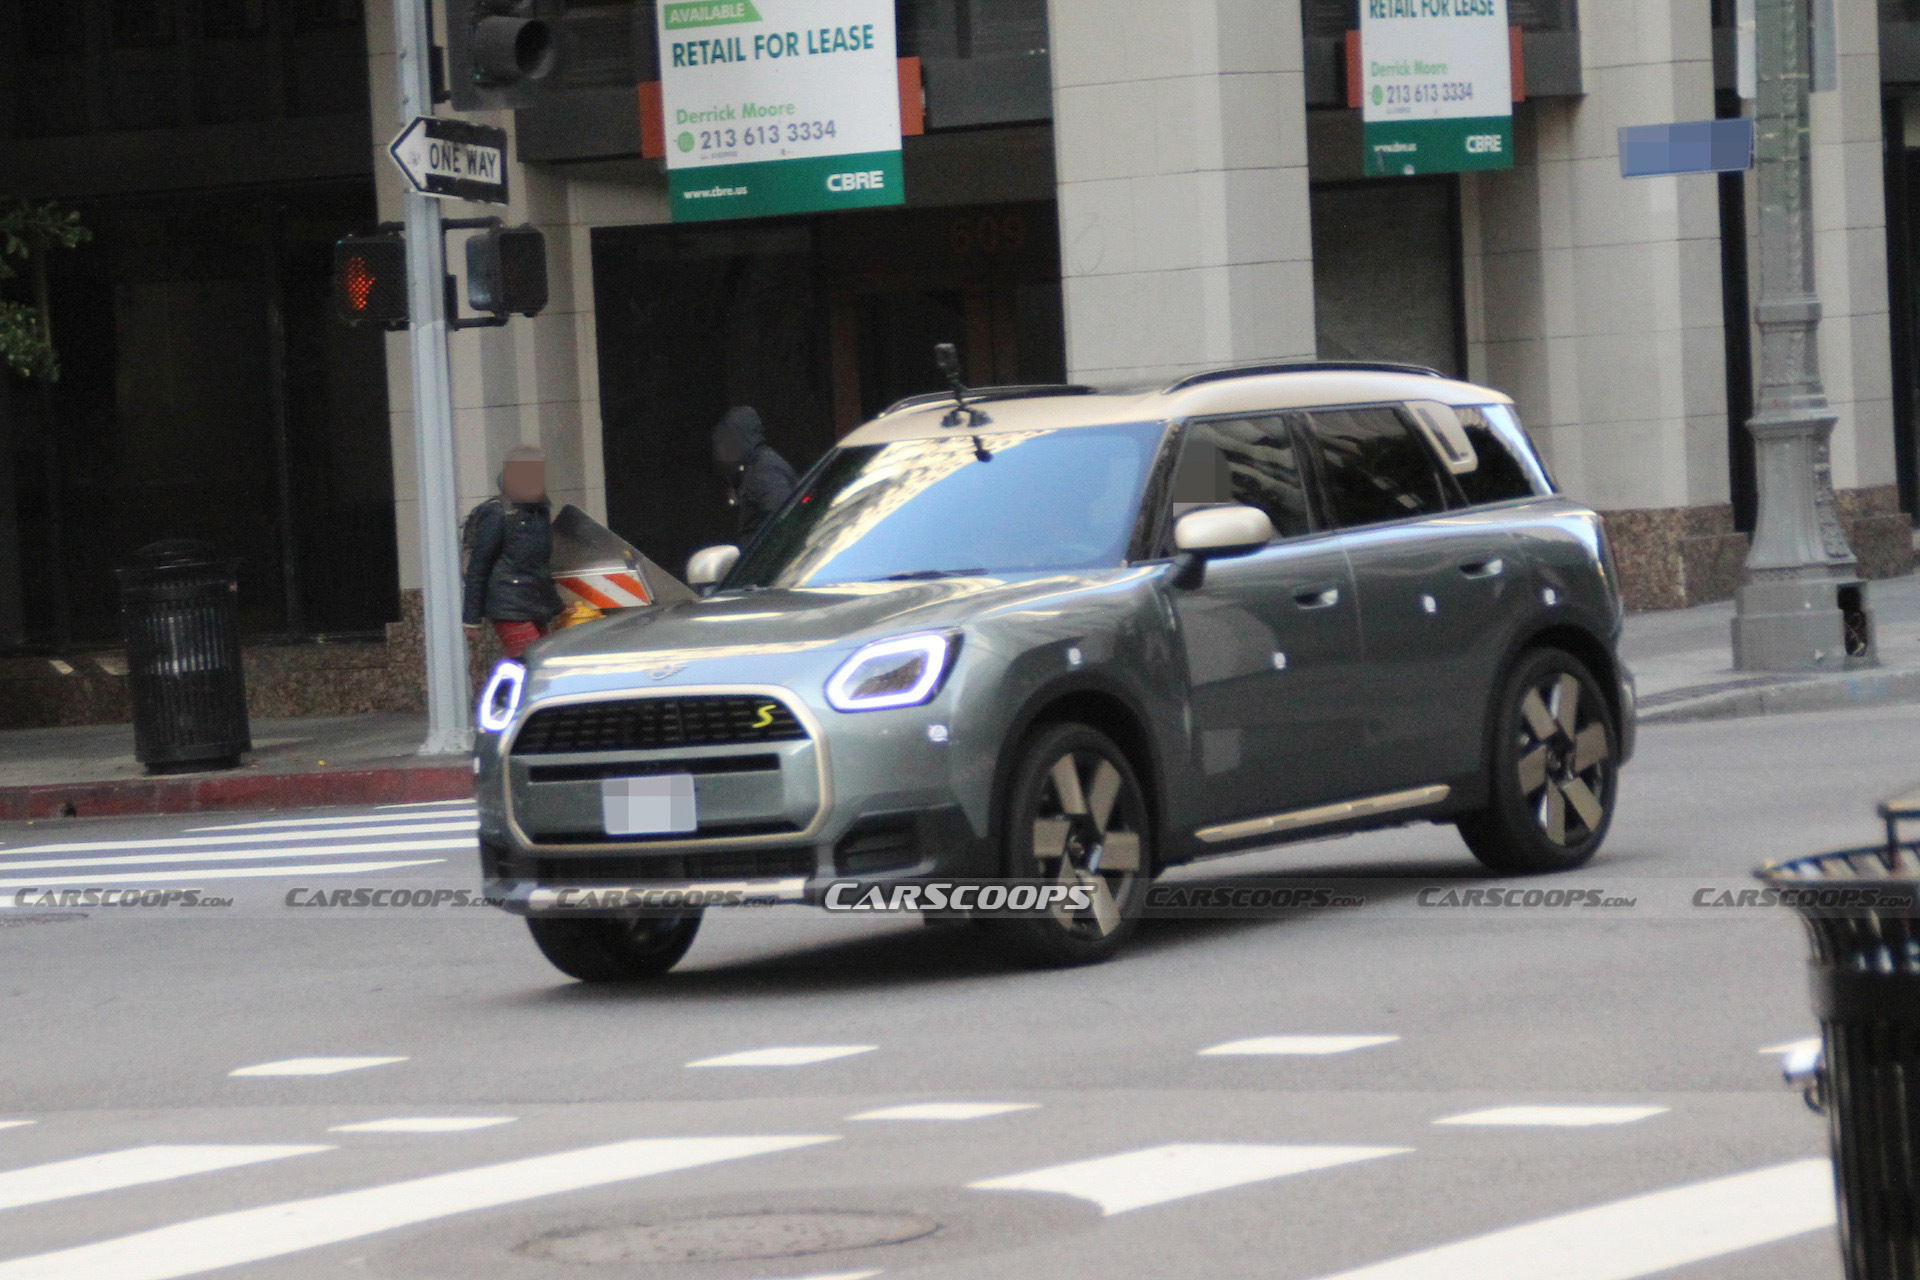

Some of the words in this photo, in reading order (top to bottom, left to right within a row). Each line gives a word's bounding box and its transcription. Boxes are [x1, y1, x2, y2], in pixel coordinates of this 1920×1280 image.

[670, 3, 745, 23] AVAILABLE
[1369, 0, 1417, 18] RETAIL
[1422, 0, 1450, 17] FOR
[1455, 0, 1495, 16] LEASE
[672, 37, 747, 67] RETAIL
[755, 32, 799, 60] FOR
[807, 24, 875, 55] LEASE
[1387, 85, 1411, 104] 213
[1415, 84, 1439, 103] 613
[1443, 82, 1473, 101] 3334
[676, 104, 737, 125] Derrick
[742, 102, 796, 120] Moore
[700, 129, 737, 150] 213
[744, 125, 781, 146] 613
[787, 120, 837, 143] 3334
[1465, 134, 1502, 153] CBRE
[430, 142, 461, 174] ONE
[466, 149, 497, 179] WAY
[826, 170, 885, 192] CBRE
[683, 186, 748, 200] www.cbre.us
[945, 213, 1027, 253] 609
[751, 704, 778, 729] S
